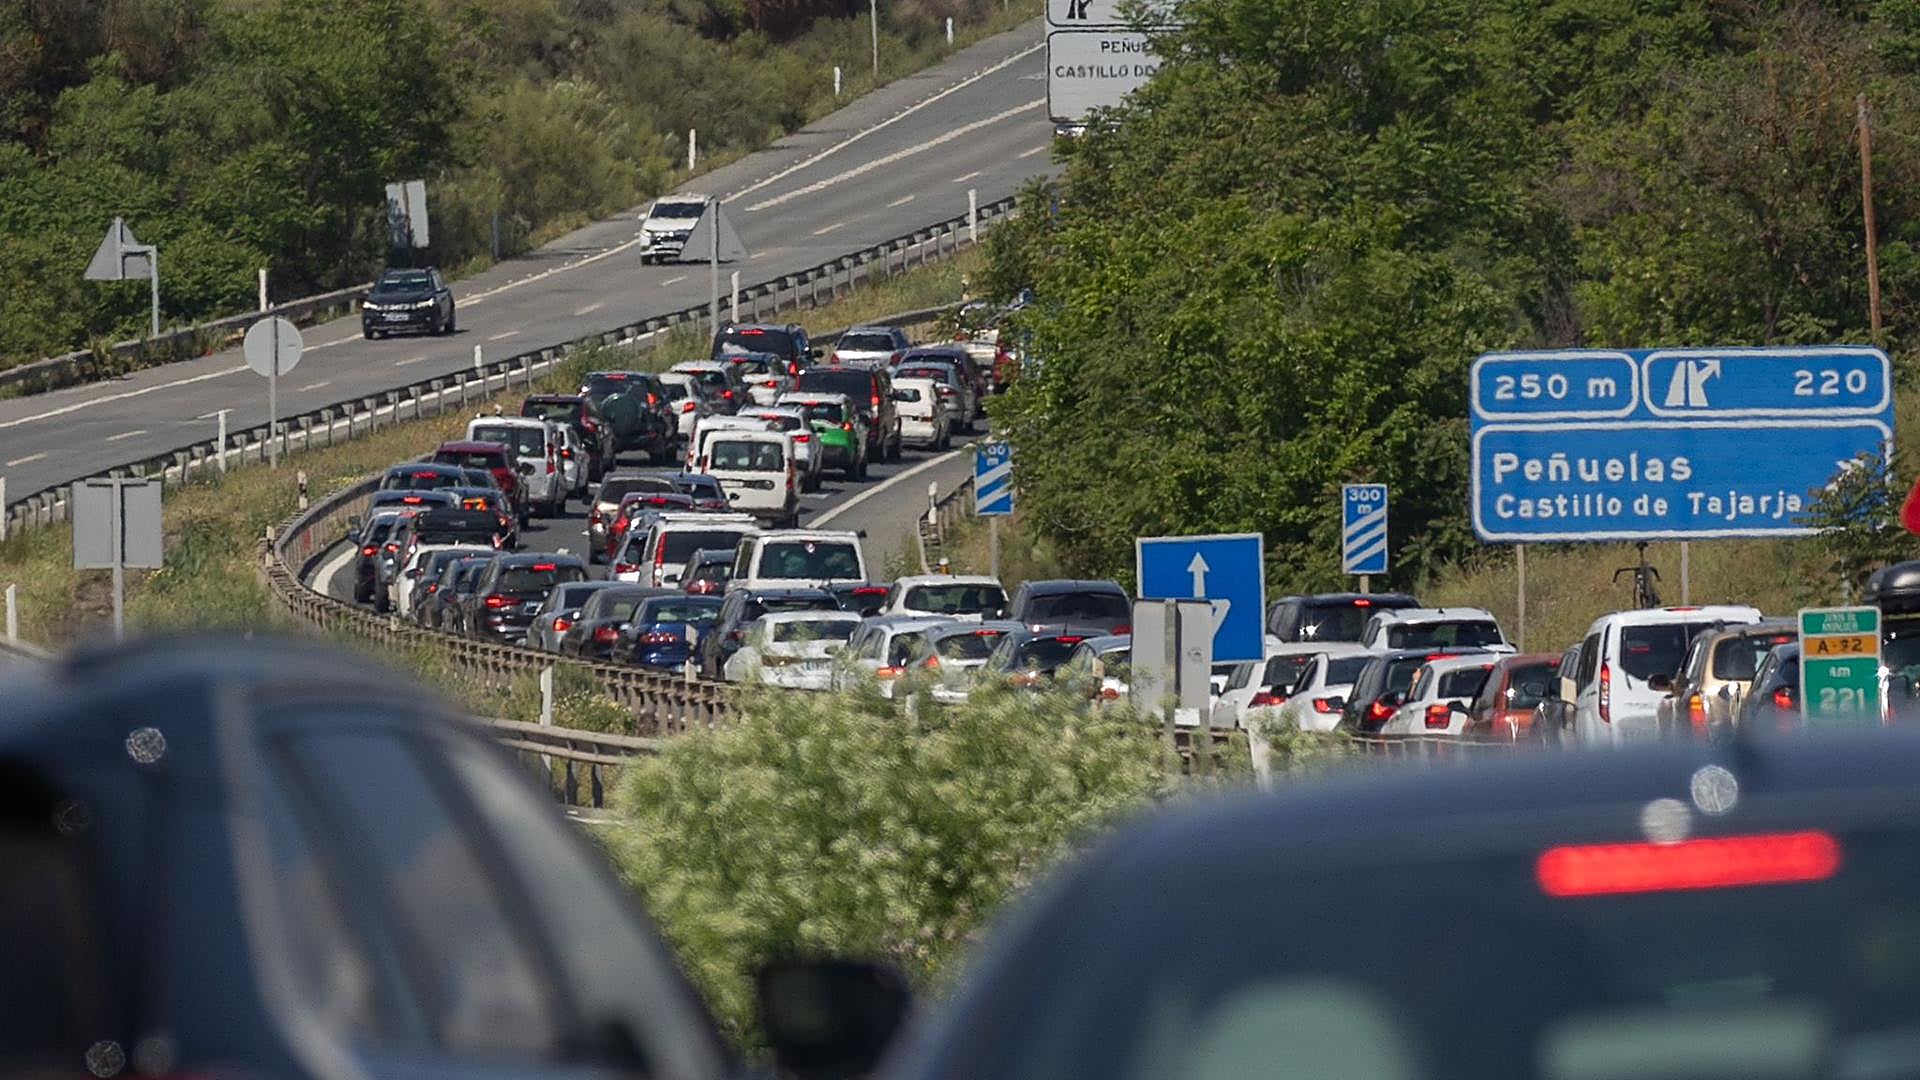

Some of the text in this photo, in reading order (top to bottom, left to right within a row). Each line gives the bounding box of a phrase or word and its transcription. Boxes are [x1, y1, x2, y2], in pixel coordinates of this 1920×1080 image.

[1101, 39, 1151, 53] PEÑUE
[1055, 65, 1128, 78] CASTILLO
[1495, 374, 1616, 399] 250 m
[1794, 369, 1866, 395] 220
[981, 445, 1006, 456] 00
[1493, 451, 1691, 483] Peñuelas
[1348, 489, 1380, 501] 300
[1357, 503, 1372, 514] m
[1495, 490, 1801, 520] Castillo de Tajarja
[1817, 639, 1863, 654] A-92
[1820, 687, 1865, 712] 221
